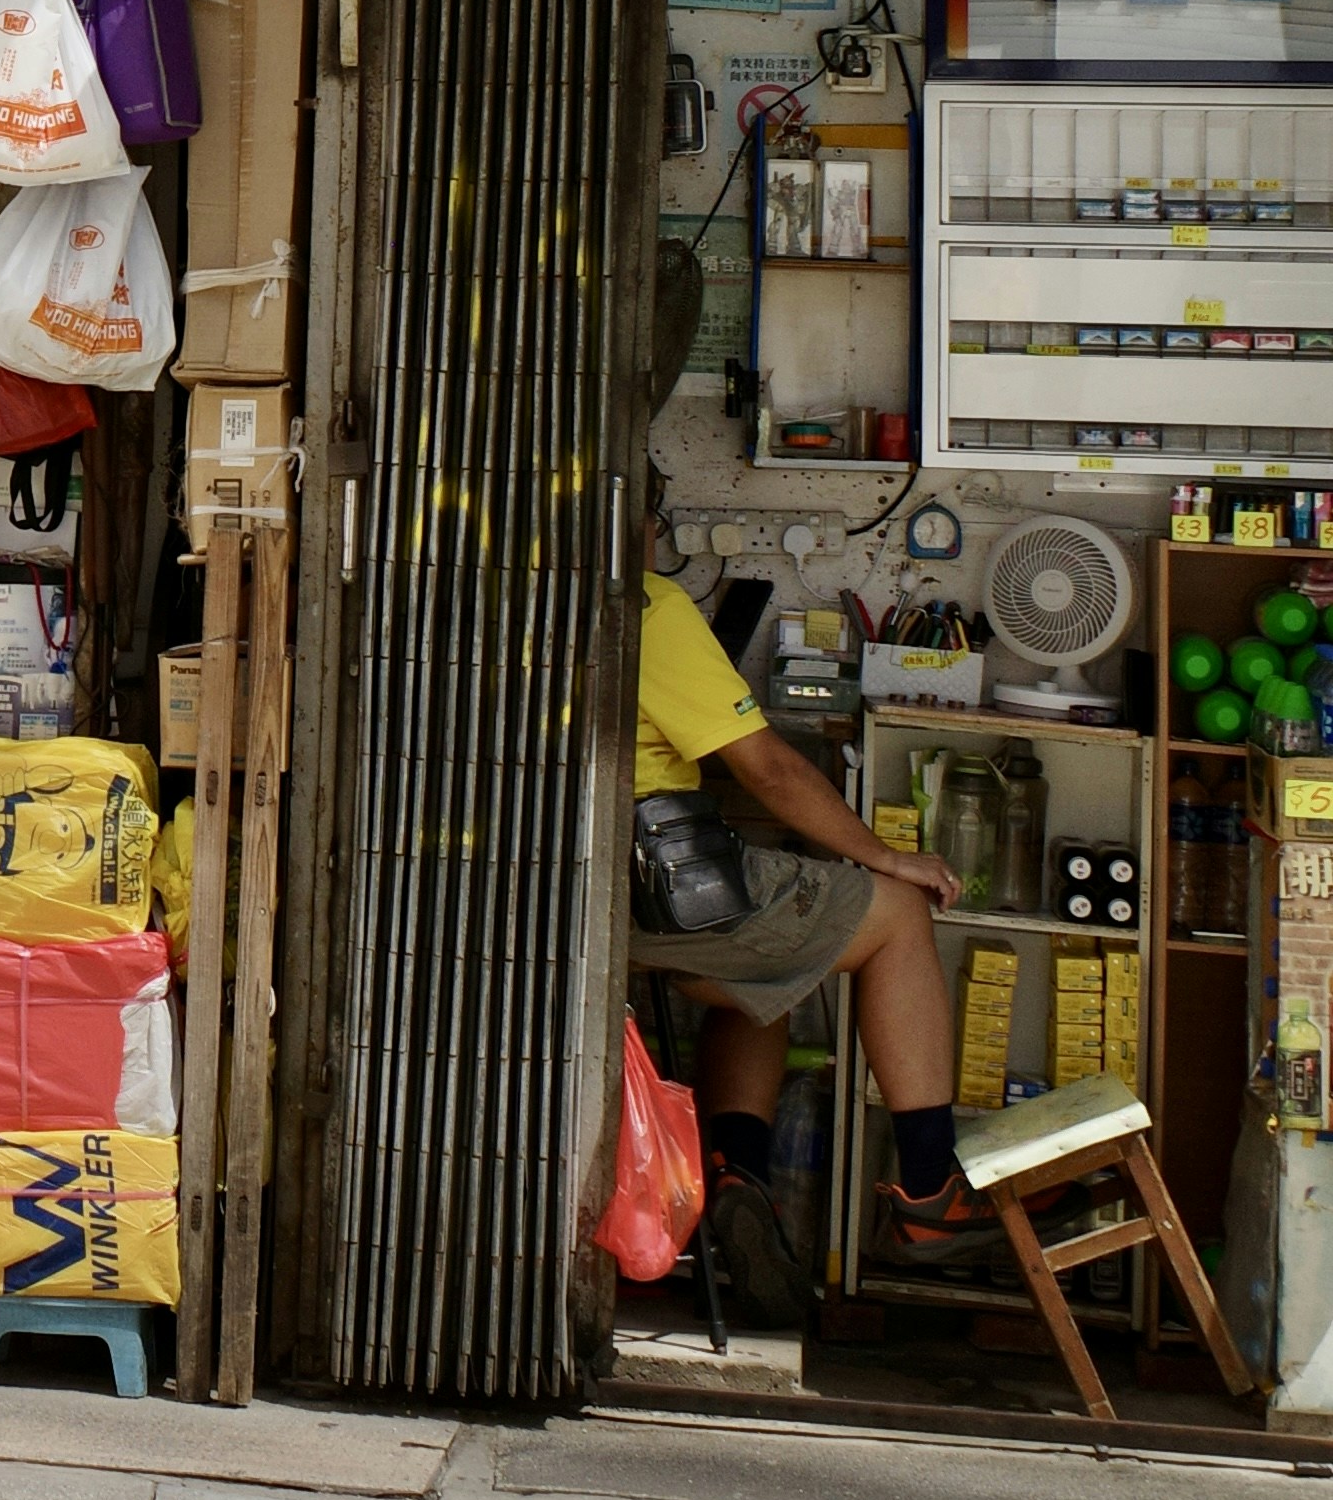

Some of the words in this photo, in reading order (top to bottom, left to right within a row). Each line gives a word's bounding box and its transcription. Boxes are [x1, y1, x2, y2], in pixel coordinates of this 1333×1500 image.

[1176, 519, 1201, 538] $3
[1239, 516, 1268, 541] $8
[1290, 786, 1332, 813] $5
[84, 1133, 119, 1292] WINKLER
